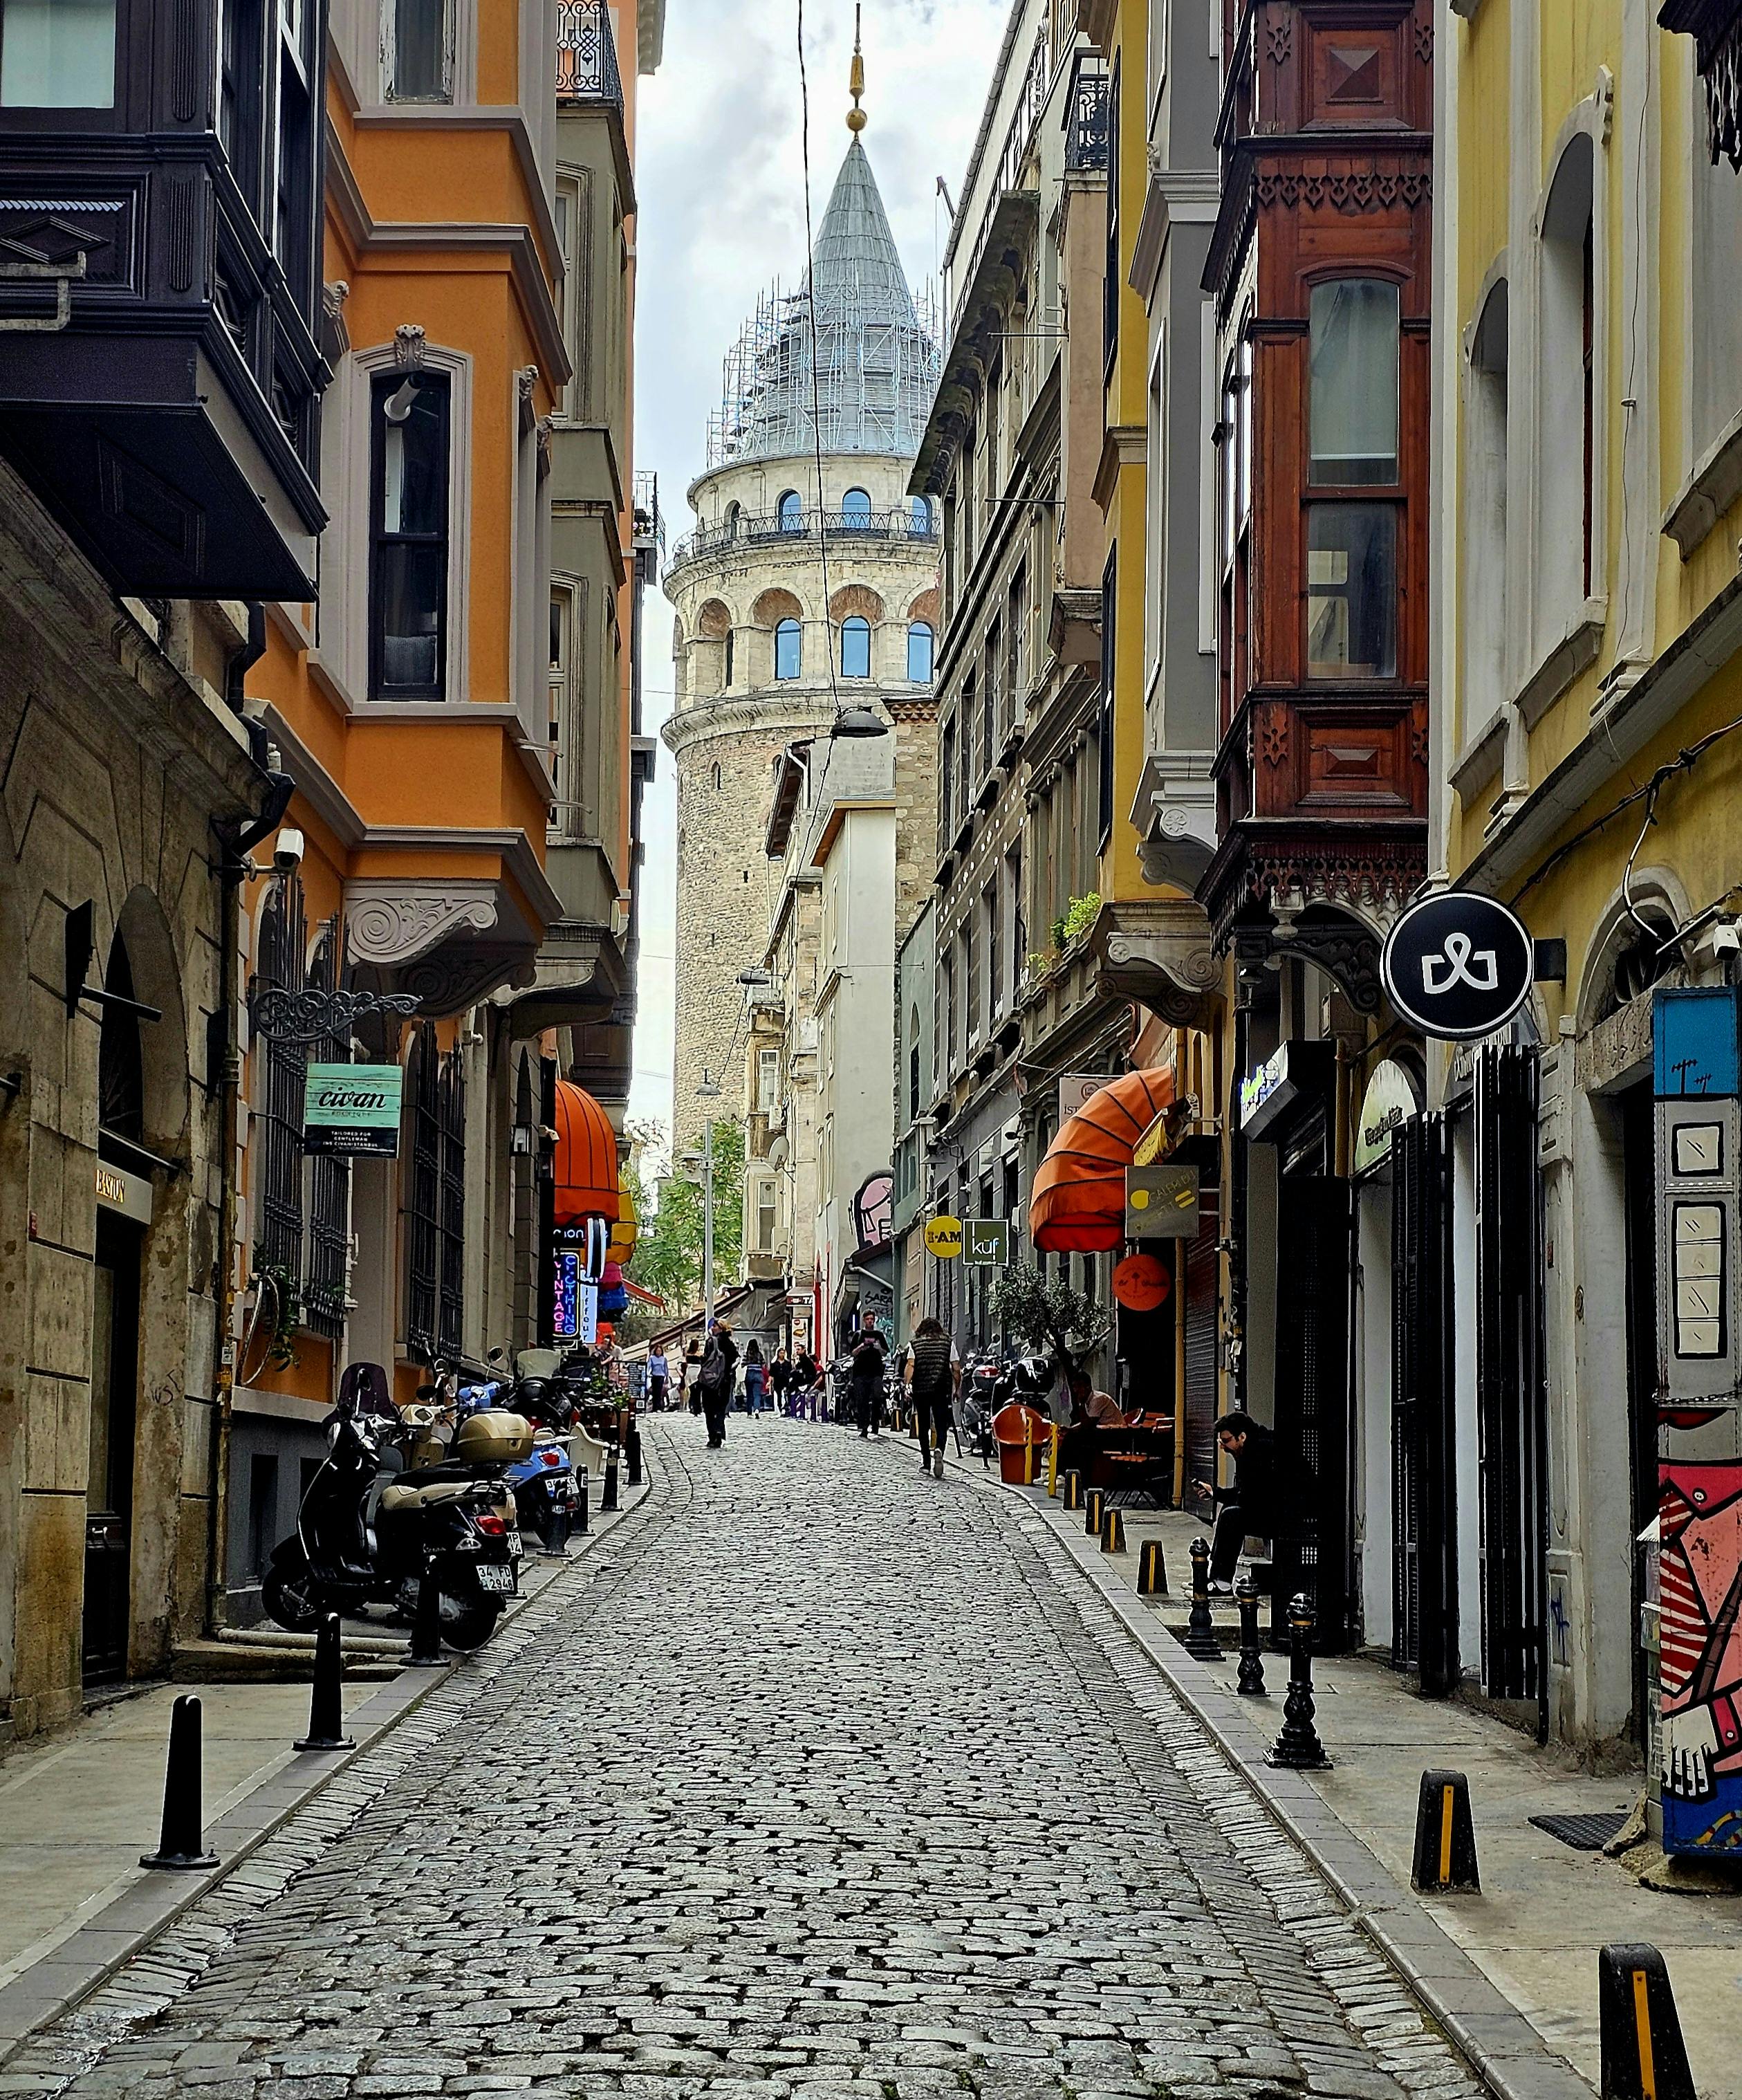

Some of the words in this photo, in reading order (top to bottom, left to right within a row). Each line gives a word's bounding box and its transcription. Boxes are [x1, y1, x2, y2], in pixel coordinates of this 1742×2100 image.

[318, 1087, 387, 1109] civan
[927, 1231, 962, 1244] I-AM
[478, 1567, 493, 1577] 34
[497, 1566, 511, 1577] FD
[489, 1578, 513, 1590] 2946
